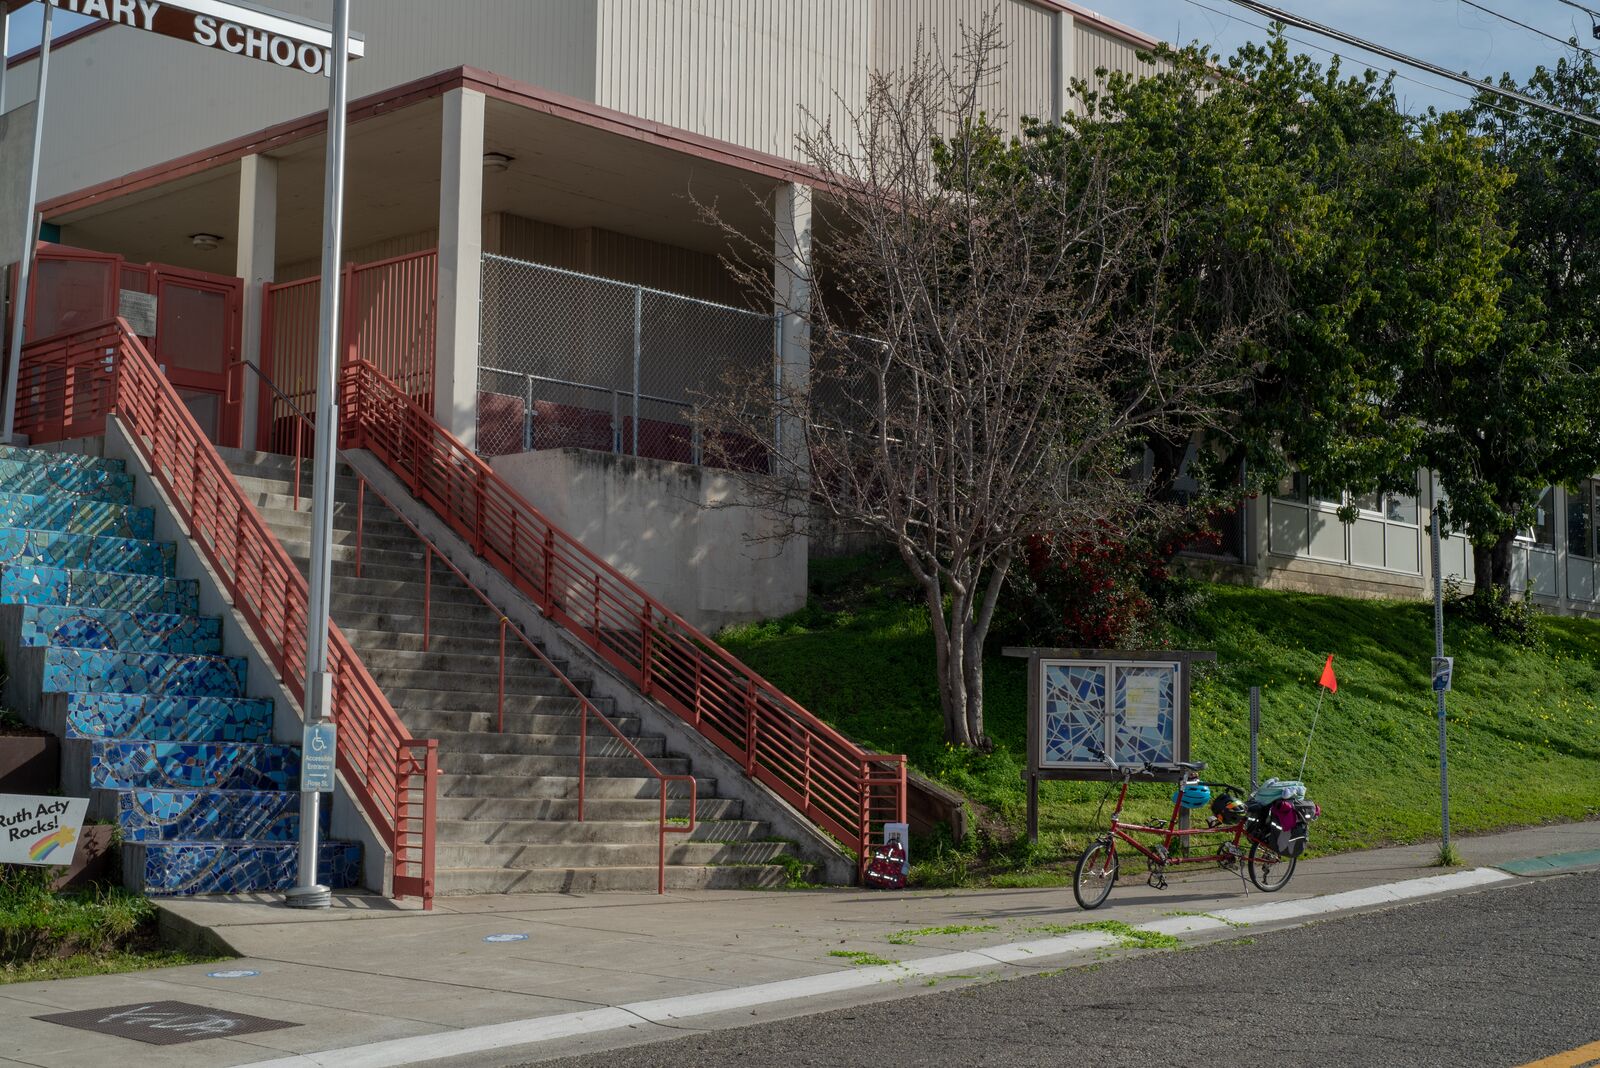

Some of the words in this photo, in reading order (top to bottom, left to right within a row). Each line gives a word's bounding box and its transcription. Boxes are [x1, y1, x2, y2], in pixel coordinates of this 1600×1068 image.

[50, 0, 161, 31] ARY
[0, 808, 32, 827] Ruth
[35, 800, 70, 818] Acty
[9, 815, 59, 841] Rocks!
